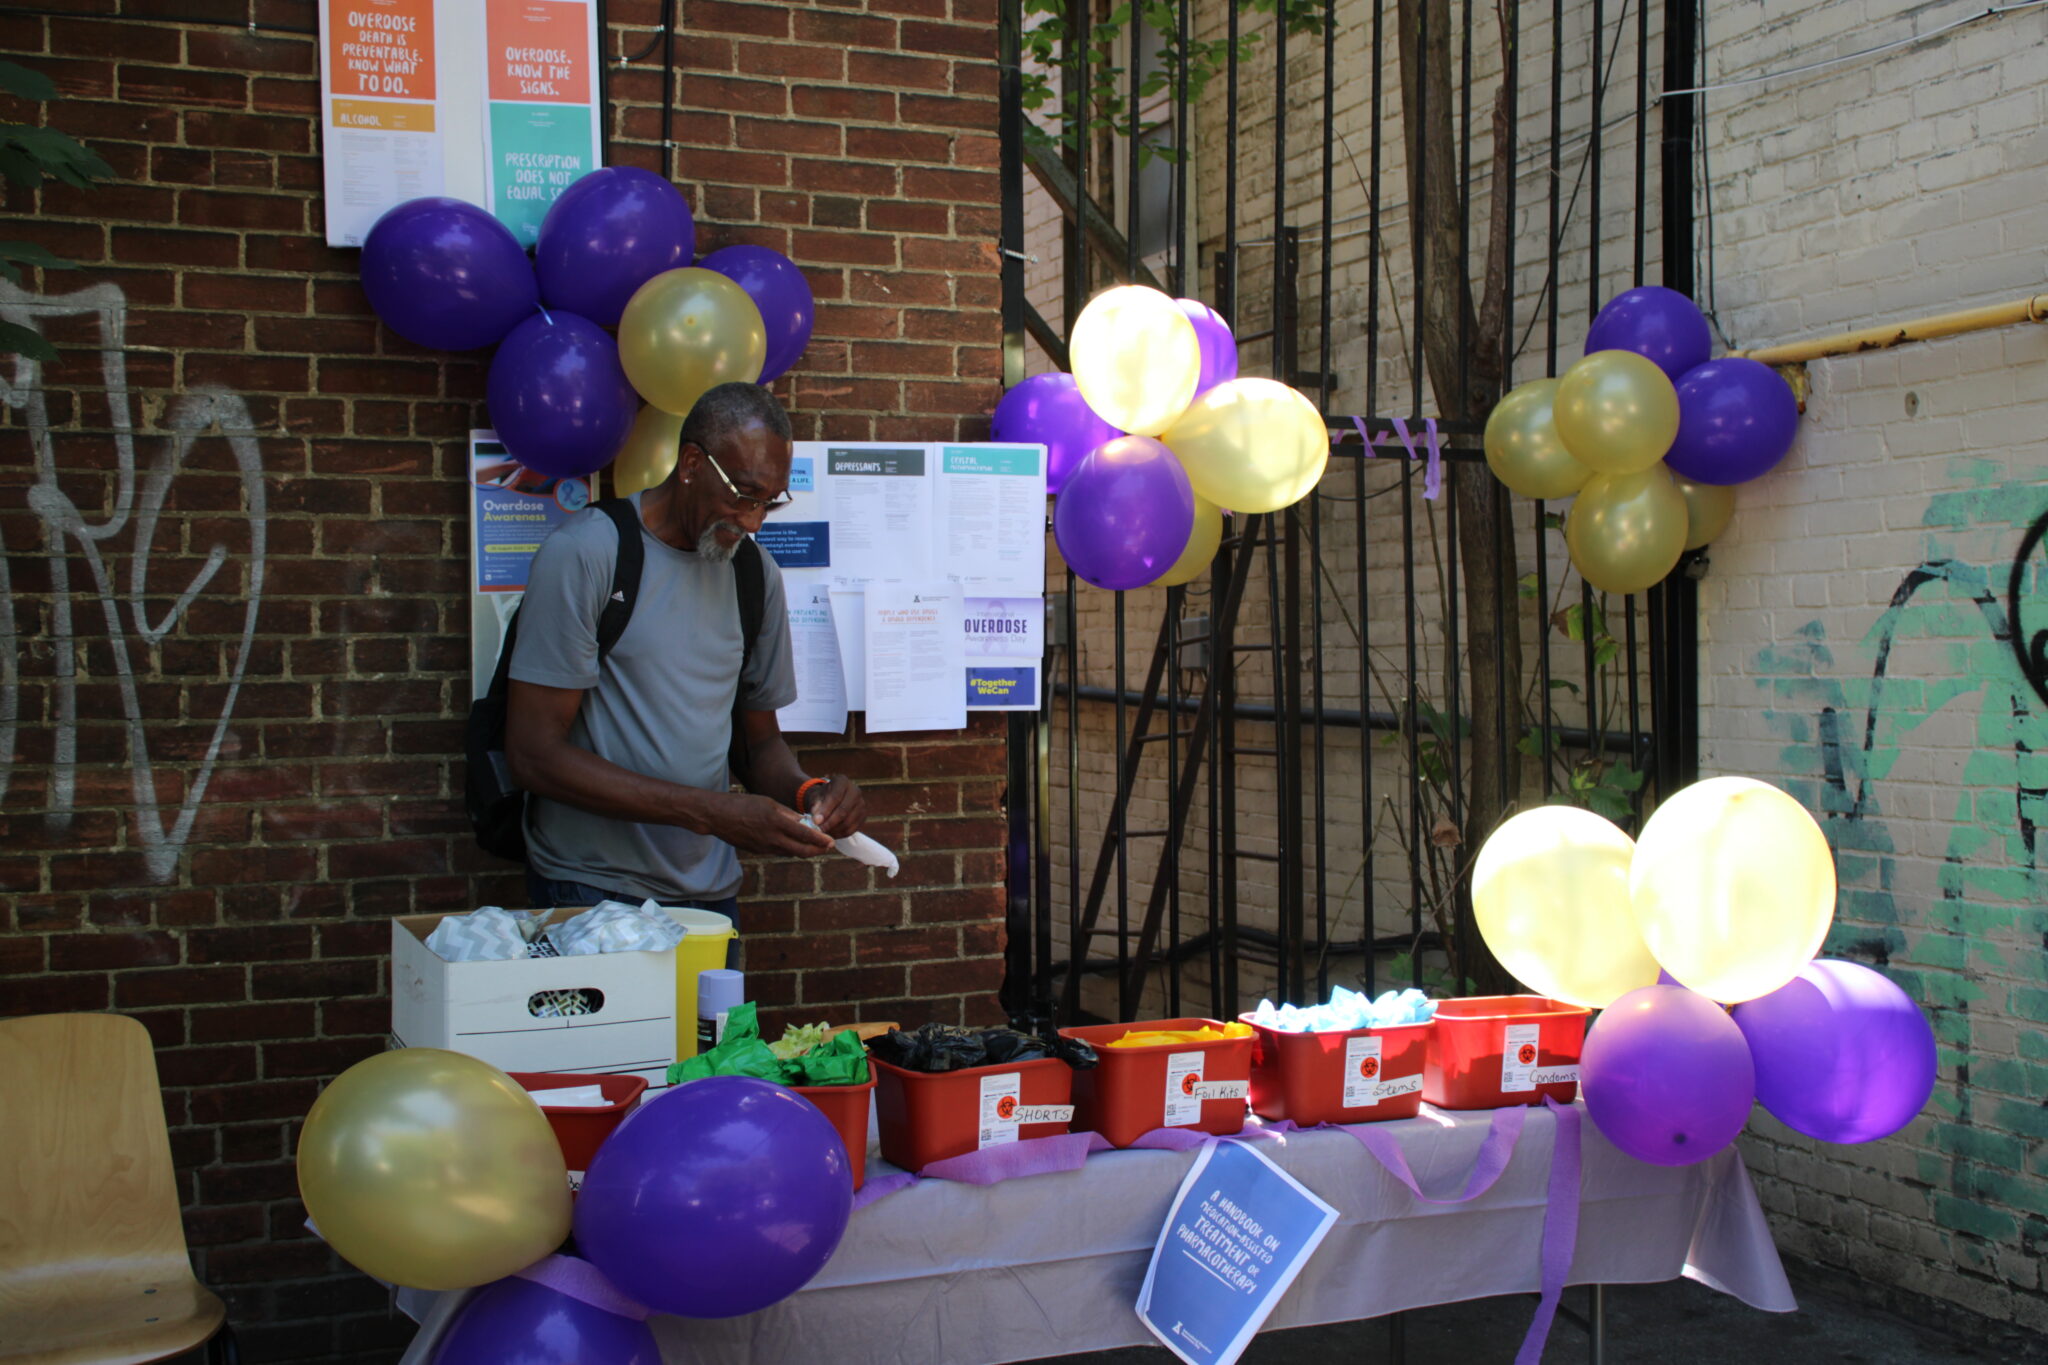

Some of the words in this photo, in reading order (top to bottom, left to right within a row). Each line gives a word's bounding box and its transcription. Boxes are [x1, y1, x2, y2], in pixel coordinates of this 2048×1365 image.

[348, 11, 416, 32] OVERDOSE
[359, 30, 393, 44] DEATH
[342, 43, 423, 62] PREVENTABLE.
[505, 46, 573, 64] OVERDOSE.
[348, 58, 379, 72] KNOW
[383, 60, 418, 75] WHAT
[507, 63, 543, 79] KNOW
[549, 65, 571, 80] THE
[358, 73, 379, 92] TO
[383, 76, 410, 94] DO.
[340, 113, 382, 126] ALCOHOL
[515, 169, 545, 184] DOES
[548, 171, 572, 185] NOT
[506, 185, 546, 201] EQUAL
[835, 462, 881, 472] DEPRESSANTS
[483, 499, 544, 511] Overdose
[483, 511, 546, 521] Awareness
[964, 619, 1027, 633] OVERDOSE
[970, 678, 1017, 688] #Together
[977, 686, 1009, 695] WeCan
[1529, 1069, 1577, 1084] Condoms
[1194, 1086, 1215, 1100] Foil
[1219, 1086, 1240, 1099] Kits
[1372, 1080, 1417, 1097] Stems
[1013, 1107, 1070, 1123] SHORTS
[1210, 1190, 1221, 1202] A
[1218, 1197, 1264, 1239] HANDBOOK
[1263, 1234, 1280, 1252] ON
[1194, 1215, 1251, 1266] TREATMENT
[1247, 1264, 1260, 1278] OR
[1177, 1223, 1258, 1295] PHARMACOTHERAPY
